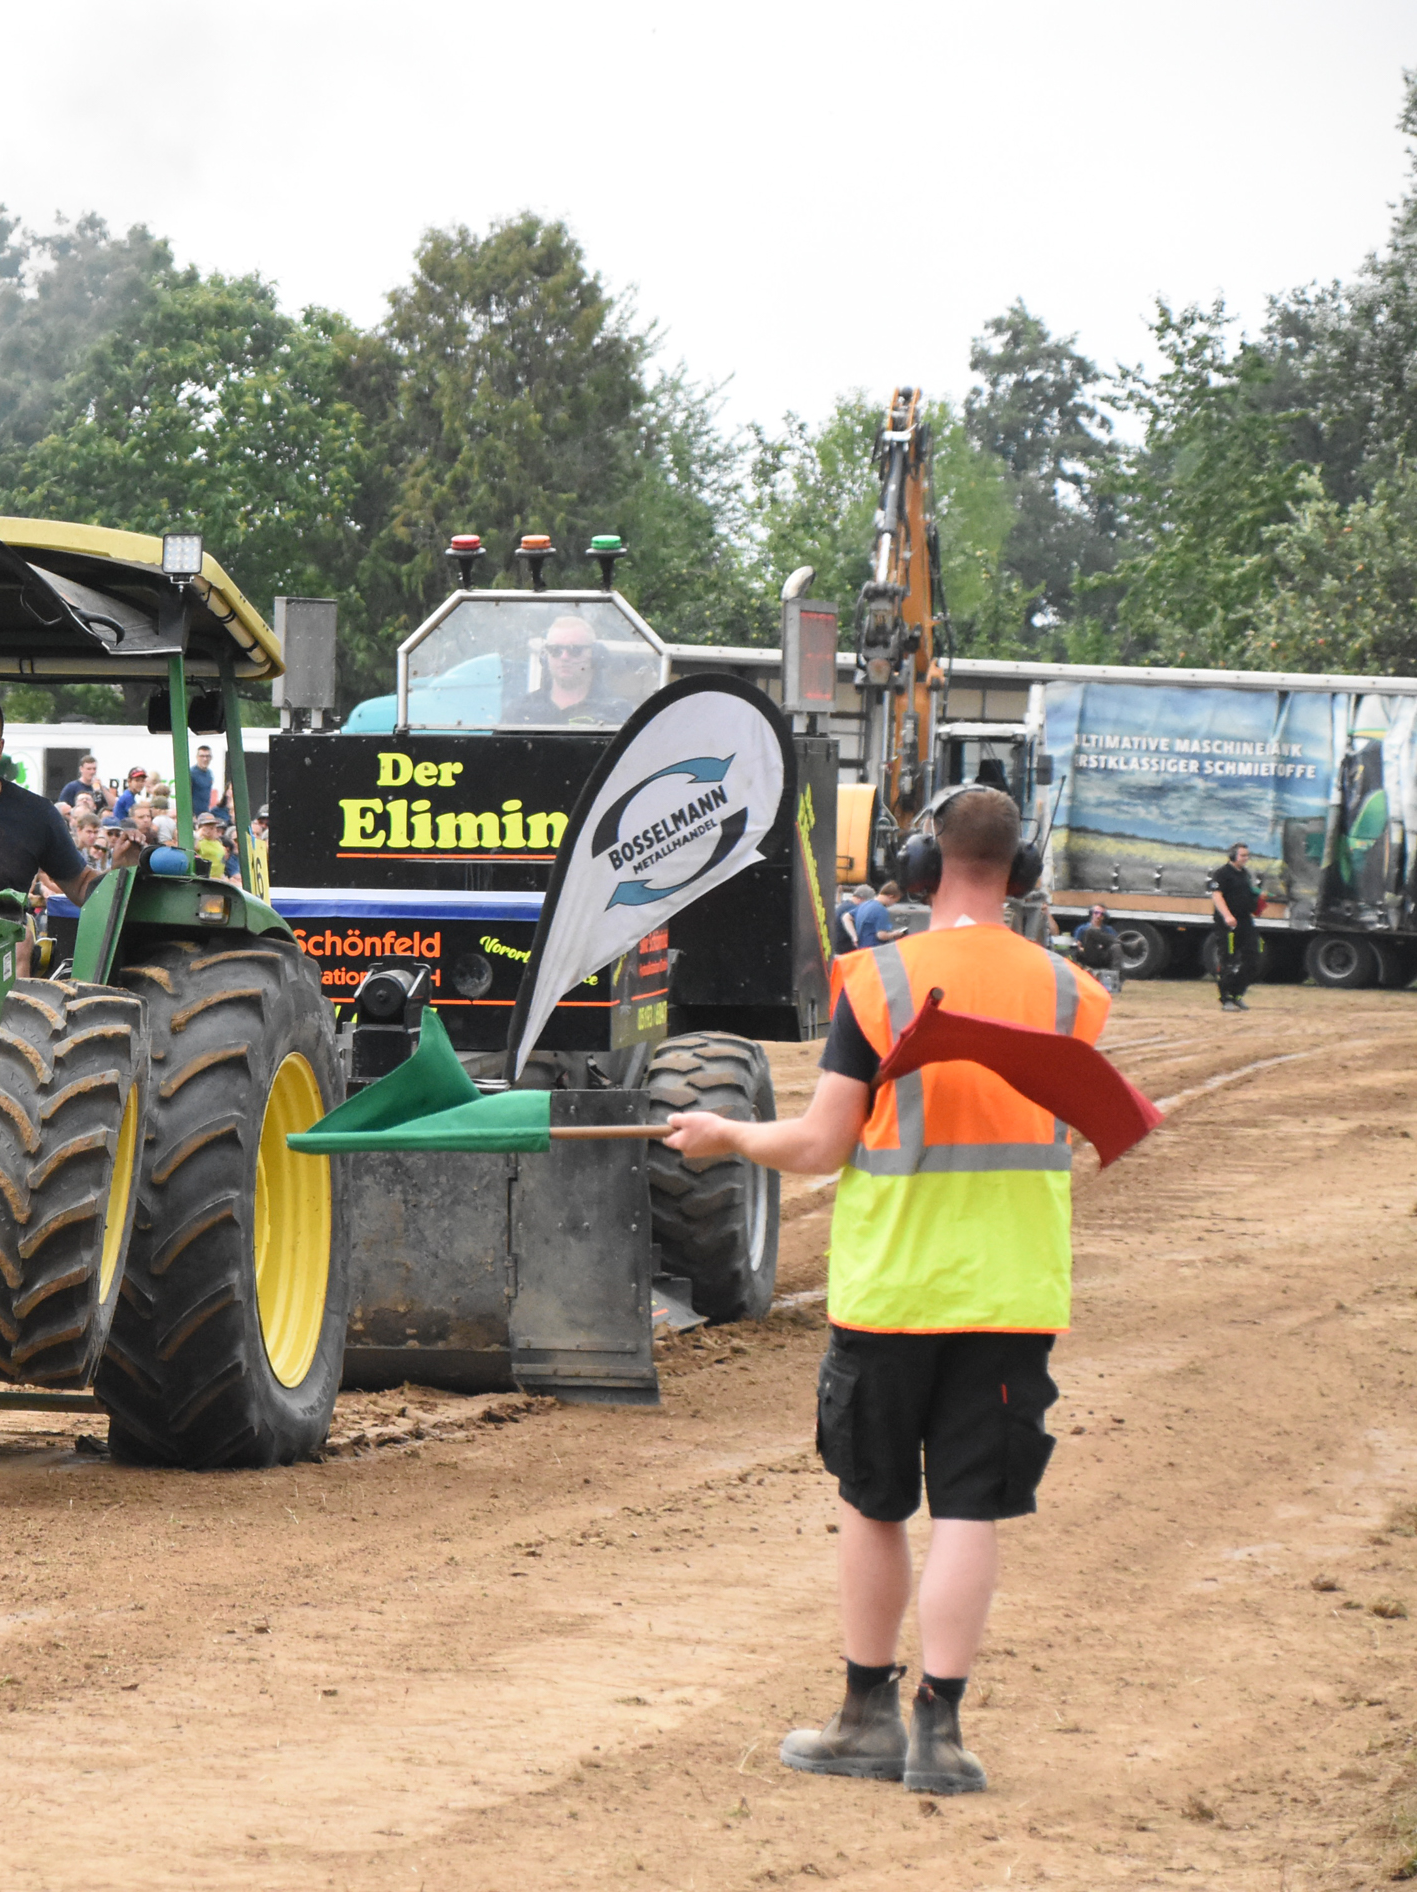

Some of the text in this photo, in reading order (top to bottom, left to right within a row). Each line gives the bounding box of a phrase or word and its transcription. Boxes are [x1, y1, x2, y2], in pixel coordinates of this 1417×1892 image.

[376, 753, 464, 787] Der
[338, 798, 570, 849] Elimin
[608, 785, 729, 872] BOSSELMANN
[632, 818, 718, 875] METALLHANDEL
[293, 929, 441, 957] Schönfeld
